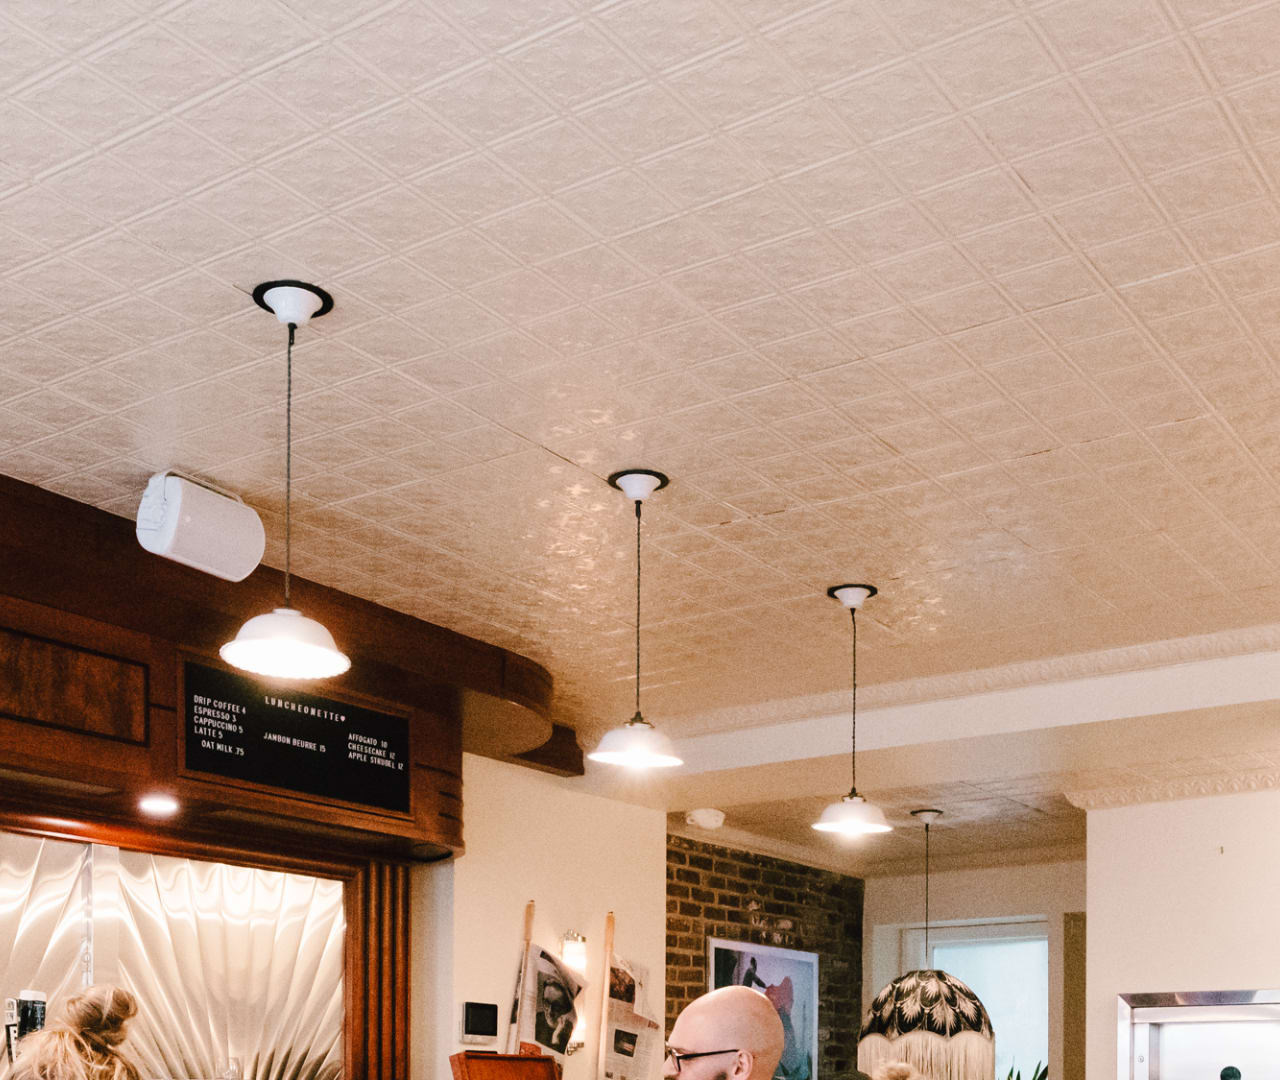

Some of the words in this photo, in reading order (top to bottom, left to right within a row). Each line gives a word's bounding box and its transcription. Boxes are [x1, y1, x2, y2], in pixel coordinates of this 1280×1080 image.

[193, 694, 211, 706] DRIP
[213, 700, 240, 714] COFFEE
[264, 696, 339, 722] LUNCHEONETTE
[194, 705, 230, 721] ESPRESSO
[193, 715, 238, 732] CAPPUCCINO
[238, 725, 244, 734] 5
[194, 725, 216, 738] LATTE
[218, 730, 223, 739] 5
[201, 739, 215, 750] OAT
[216, 742, 233, 753] MILK
[263, 732, 291, 745] JAMBON
[292, 737, 317, 752] BEURRE
[348, 732, 378, 746] AFFOGATO
[347, 742, 387, 758] CHEESECAKE
[348, 751, 367, 762] APPLE
[370, 756, 396, 769] STRUDEL
